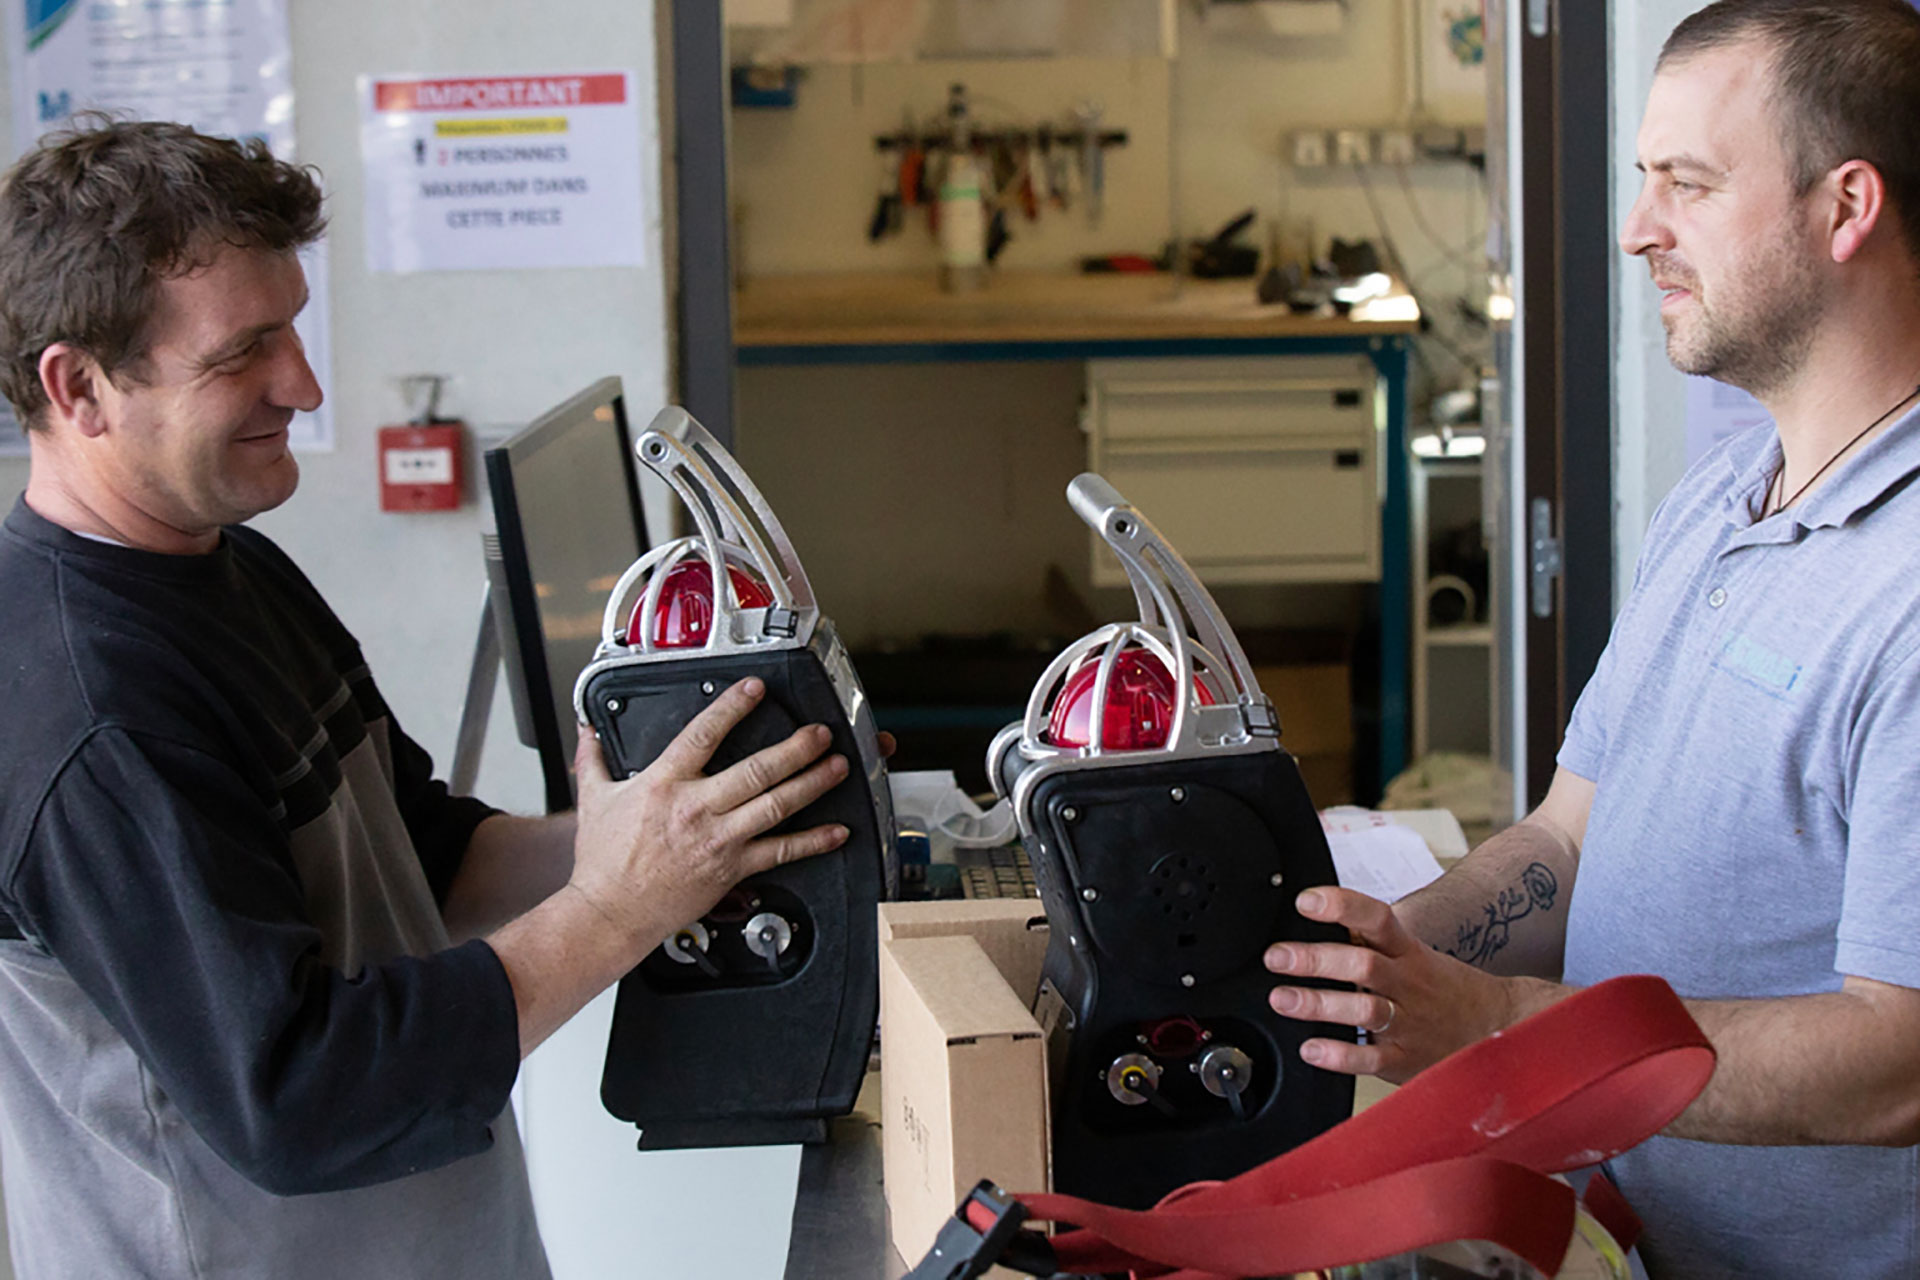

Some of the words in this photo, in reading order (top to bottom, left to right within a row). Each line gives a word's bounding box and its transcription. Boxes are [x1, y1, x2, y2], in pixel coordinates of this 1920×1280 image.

[416, 80, 582, 107] IMPORTANT
[454, 145, 568, 163] PERSONNES
[421, 179, 528, 198] MAXIMUM
[534, 177, 588, 194] DANS
[447, 209, 503, 229] CETTE
